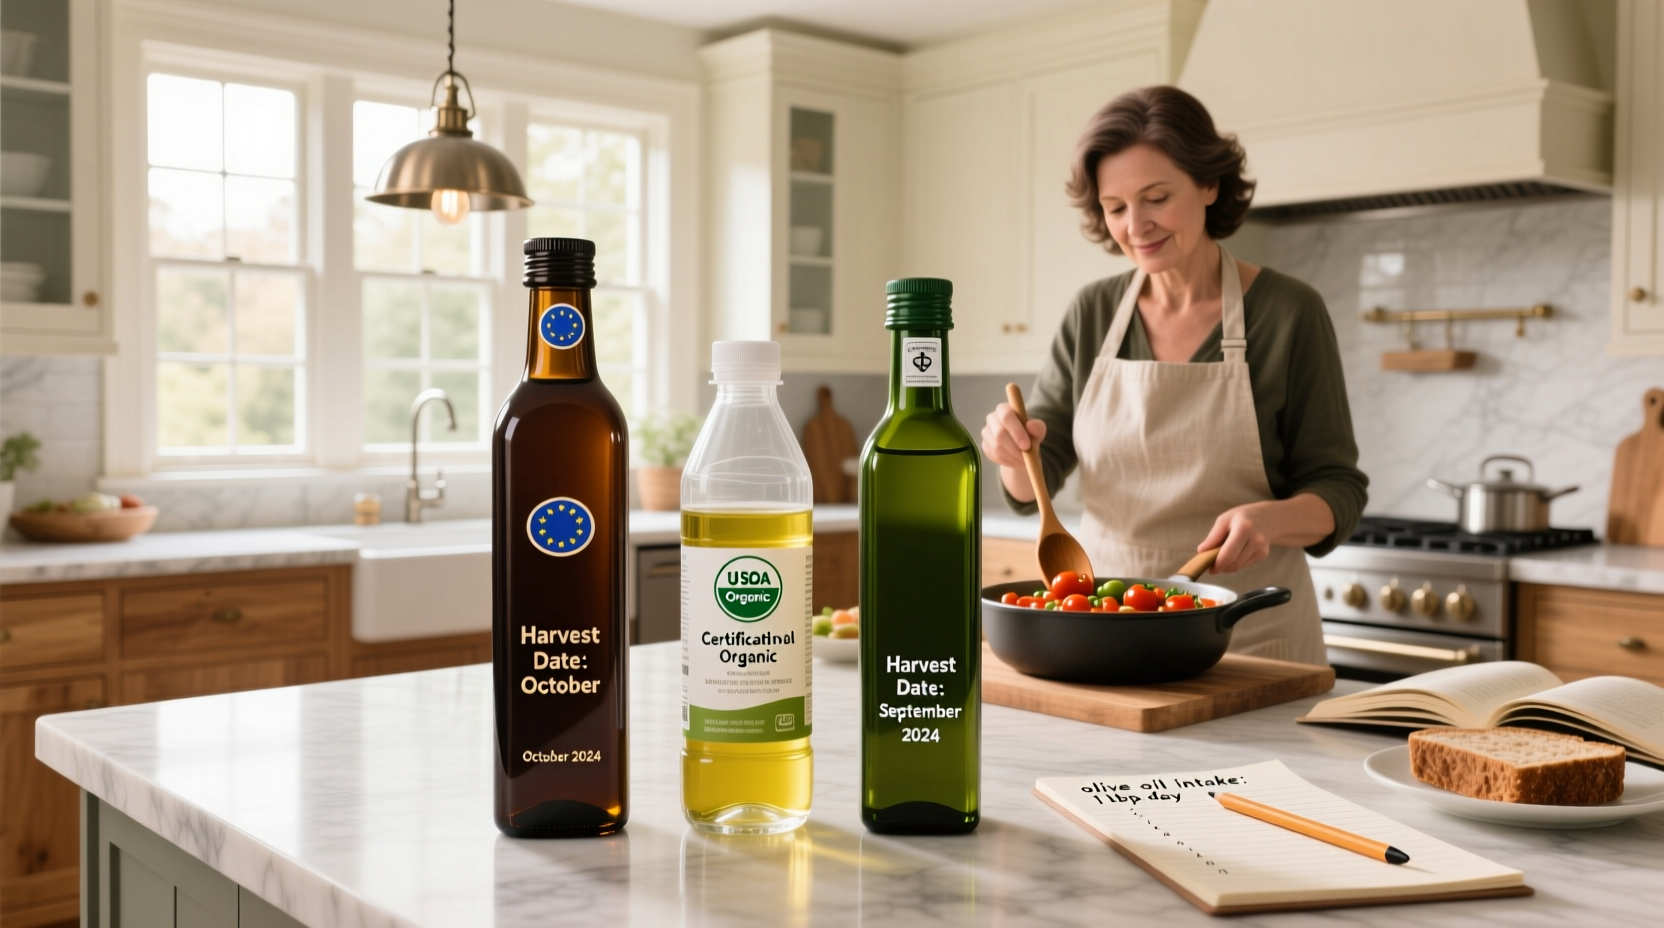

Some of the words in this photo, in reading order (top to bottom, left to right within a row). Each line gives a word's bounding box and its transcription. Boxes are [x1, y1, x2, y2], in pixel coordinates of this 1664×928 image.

[725, 590, 771, 605] Organic
[520, 625, 601, 645] Harvest
[533, 651, 588, 670] Date:
[719, 649, 778, 668] Organic
[886, 655, 957, 673] Harvest
[520, 675, 601, 695] October
[896, 678, 945, 696] Date:
[879, 703, 962, 723] September
[901, 727, 940, 743] 2024
[522, 750, 569, 762] October
[571, 750, 601, 762] 2024
[1081, 782, 1131, 793] olive
[1140, 779, 1168, 790] oil
